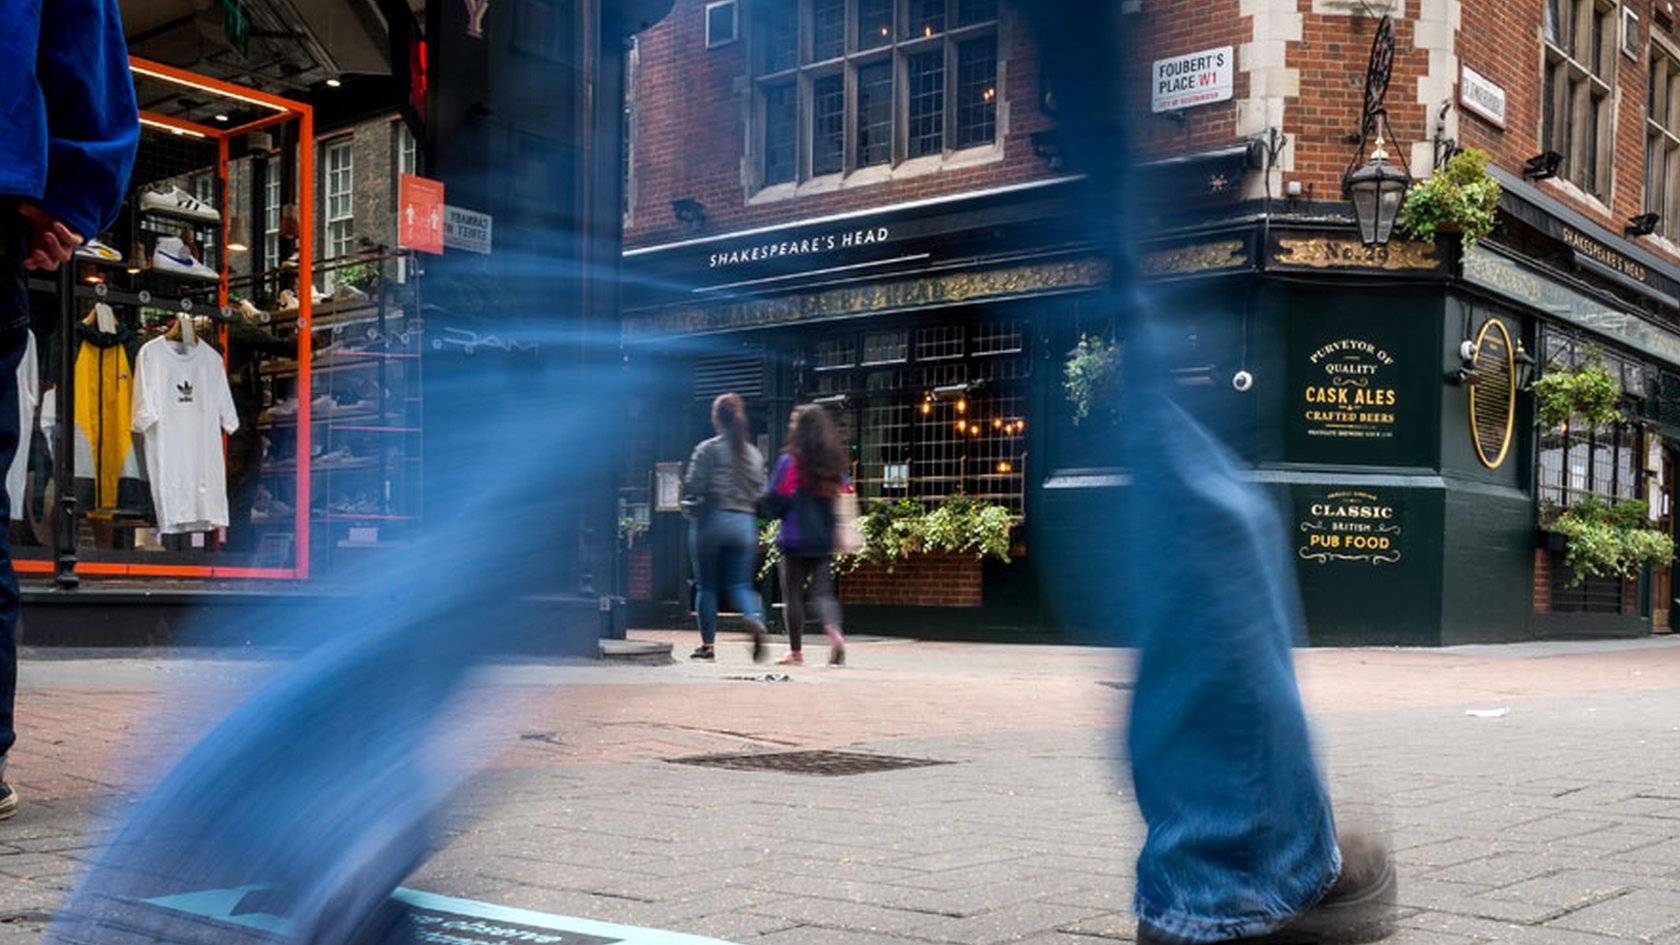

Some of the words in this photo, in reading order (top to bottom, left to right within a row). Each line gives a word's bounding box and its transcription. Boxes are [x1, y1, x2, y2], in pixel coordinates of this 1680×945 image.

[1159, 53, 1224, 78] FOUBERT'S
[1159, 75, 1195, 94] PLACE
[1200, 71, 1217, 86] W1
[709, 235, 835, 268] SHAKESPEARE'S
[841, 227, 889, 248] HEAD
[1310, 340, 1376, 363] PURVEYOR
[1376, 350, 1394, 364] OF
[1325, 363, 1377, 375] QUALITY
[1305, 386, 1349, 404] CASK
[1355, 388, 1396, 406] ALES
[1305, 410, 1357, 422] CRAFTED
[1359, 412, 1395, 423] BEERS
[1311, 503, 1393, 519] CLASSIC
[1332, 522, 1371, 532] BRITISH
[1310, 534, 1340, 548] PUB
[1345, 535, 1390, 550] FOOD
